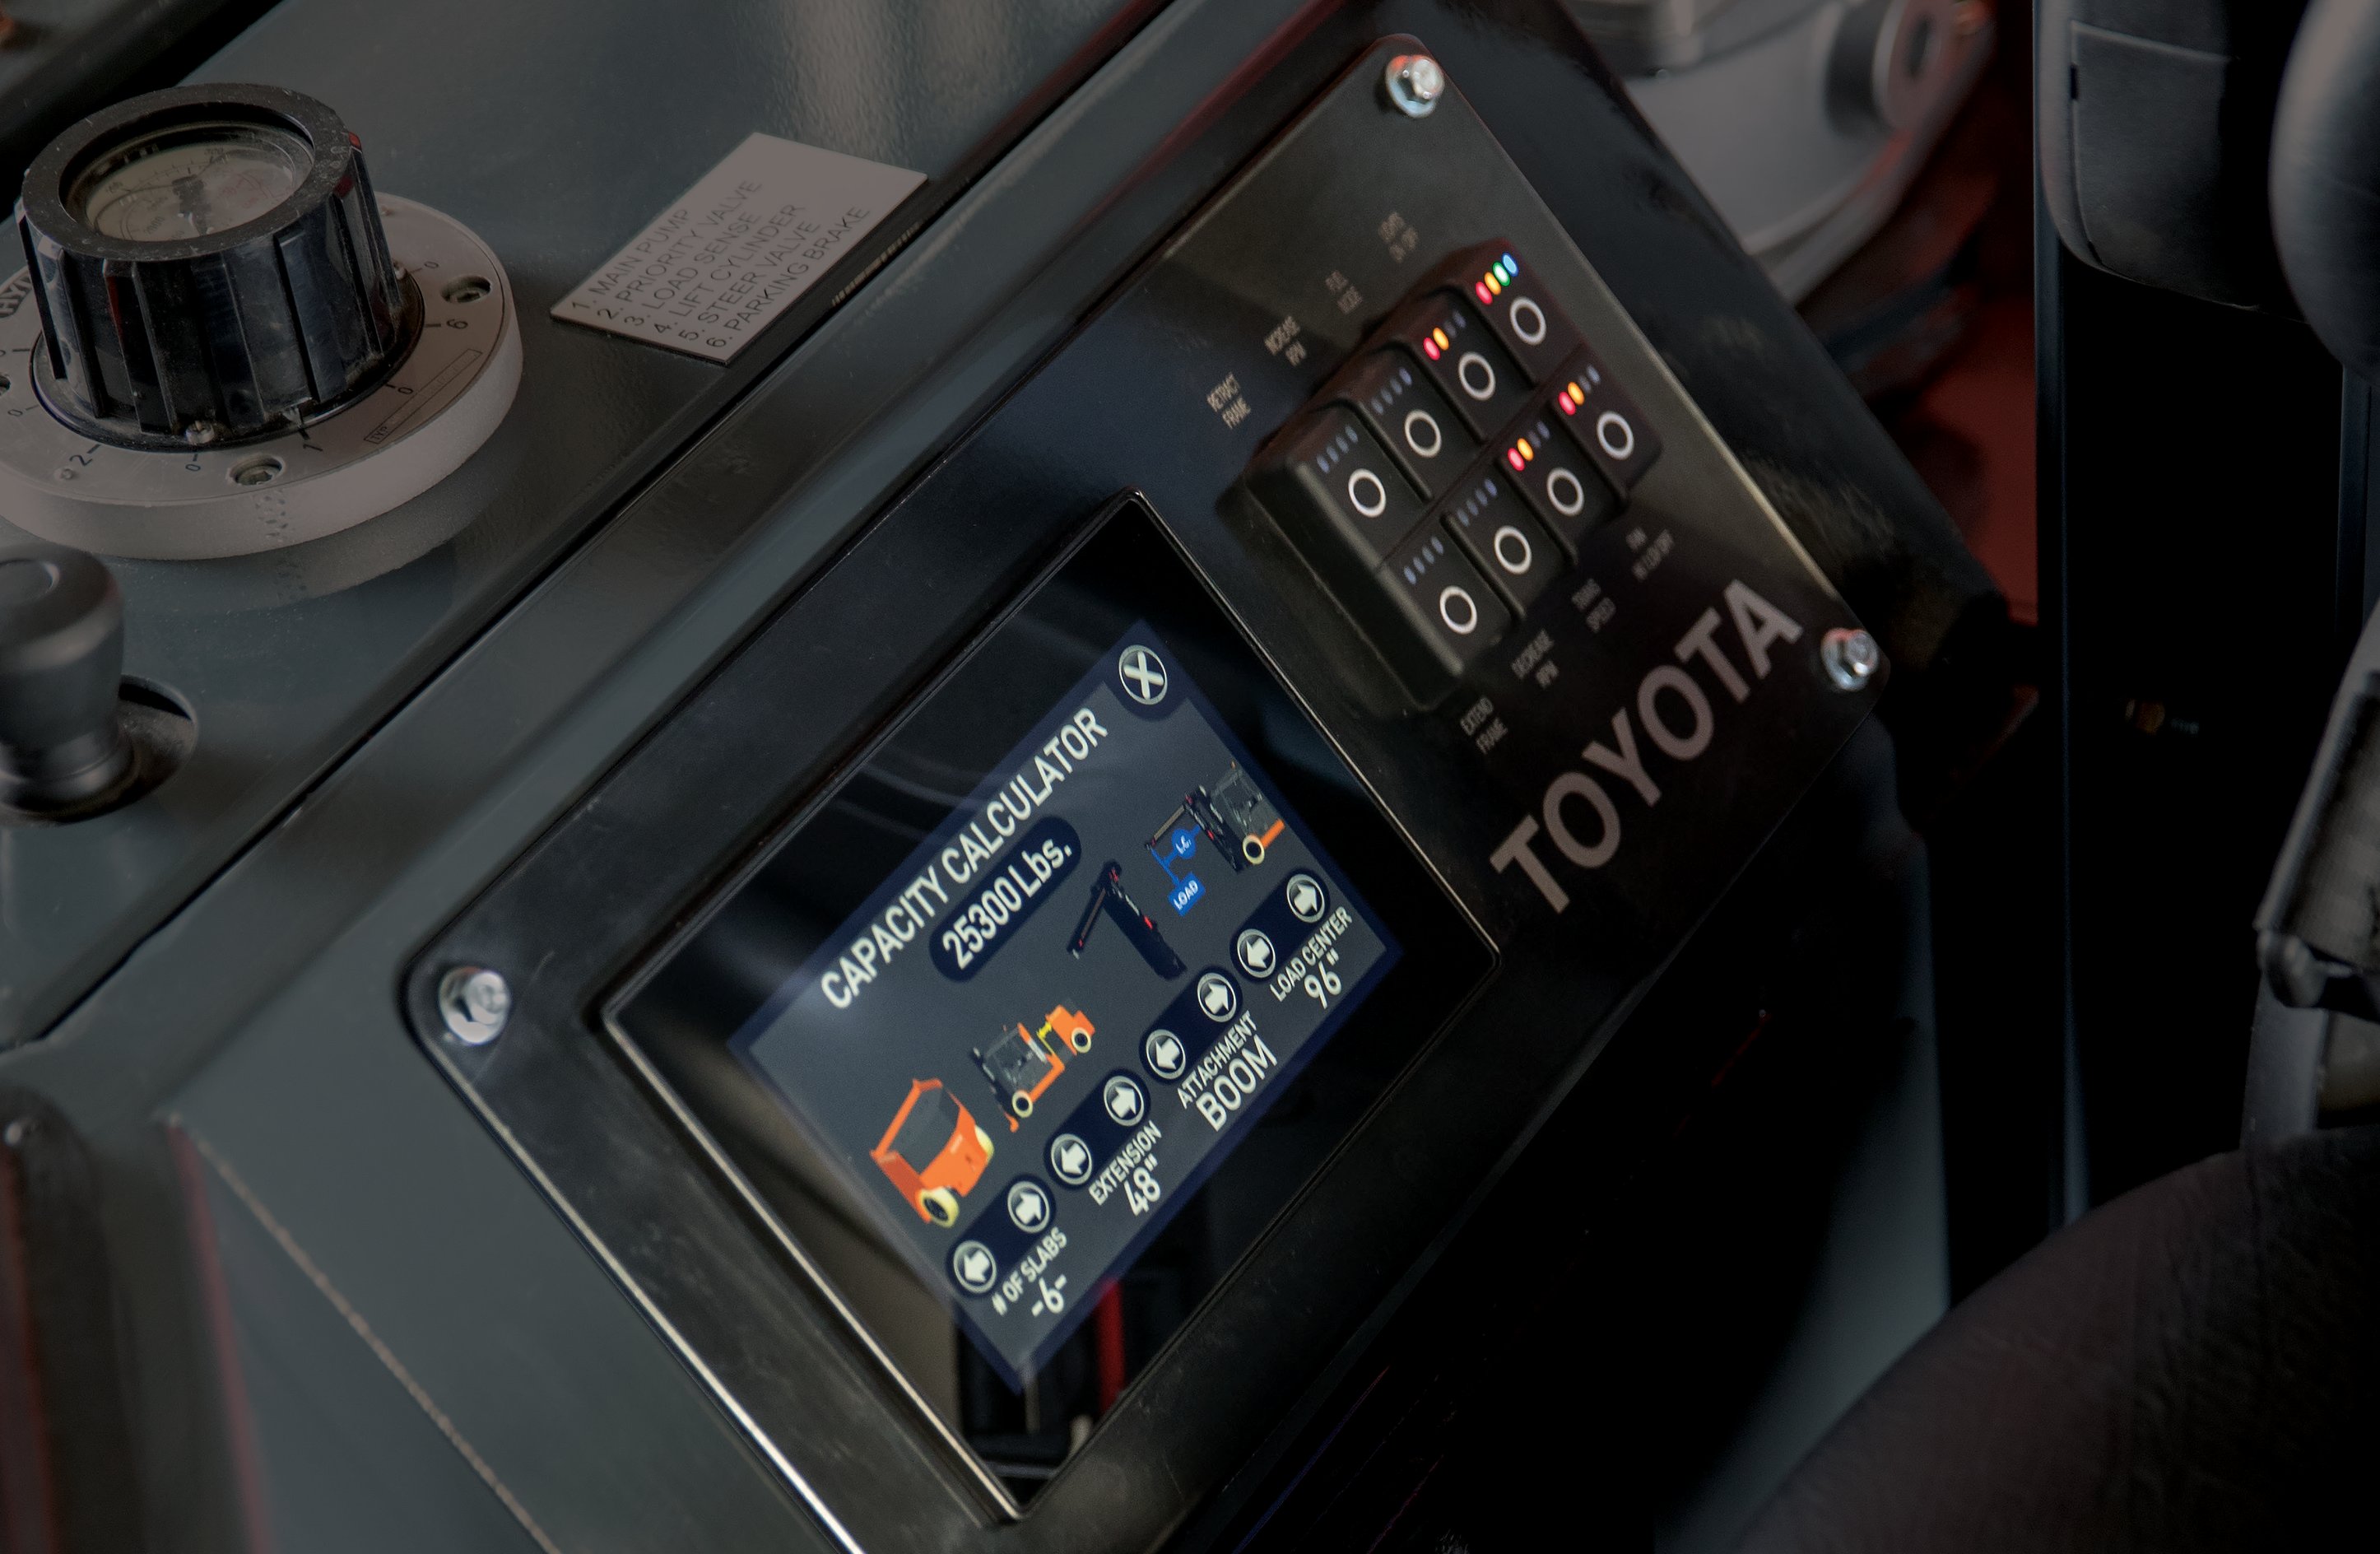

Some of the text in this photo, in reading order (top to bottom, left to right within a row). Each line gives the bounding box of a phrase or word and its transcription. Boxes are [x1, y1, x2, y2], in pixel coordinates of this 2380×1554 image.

[571, 209, 690, 310] 1. MAIN PUMP
[597, 179, 762, 320] 2. PRIORITY VALVE
[625, 212, 760, 327] 3. LOAD SENSE
[653, 204, 805, 334] 4. LIFT CYLINDER
[678, 221, 820, 342] 5. STEER VALVE
[706, 206, 870, 348] 6. PARKING BRAKE
[1490, 579, 1804, 914] TOYOTA
[821, 708, 1108, 1008] CAPACITY CALCULATOR
[943, 838, 1072, 970] 25300 Lbs.
[1174, 880, 1199, 910] LOAD
[1270, 906, 1353, 1002] LOAD CENTER
[1304, 948, 1342, 1009] 96"
[1177, 1010, 1257, 1109] ATTACHMENT
[1196, 1034, 1277, 1132] BOOM
[1088, 1120, 1162, 1206] EXTENSION
[1124, 1153, 1161, 1217] 48"
[1002, 1270, 1023, 1302] OF
[1020, 1226, 1067, 1282] SLABS
